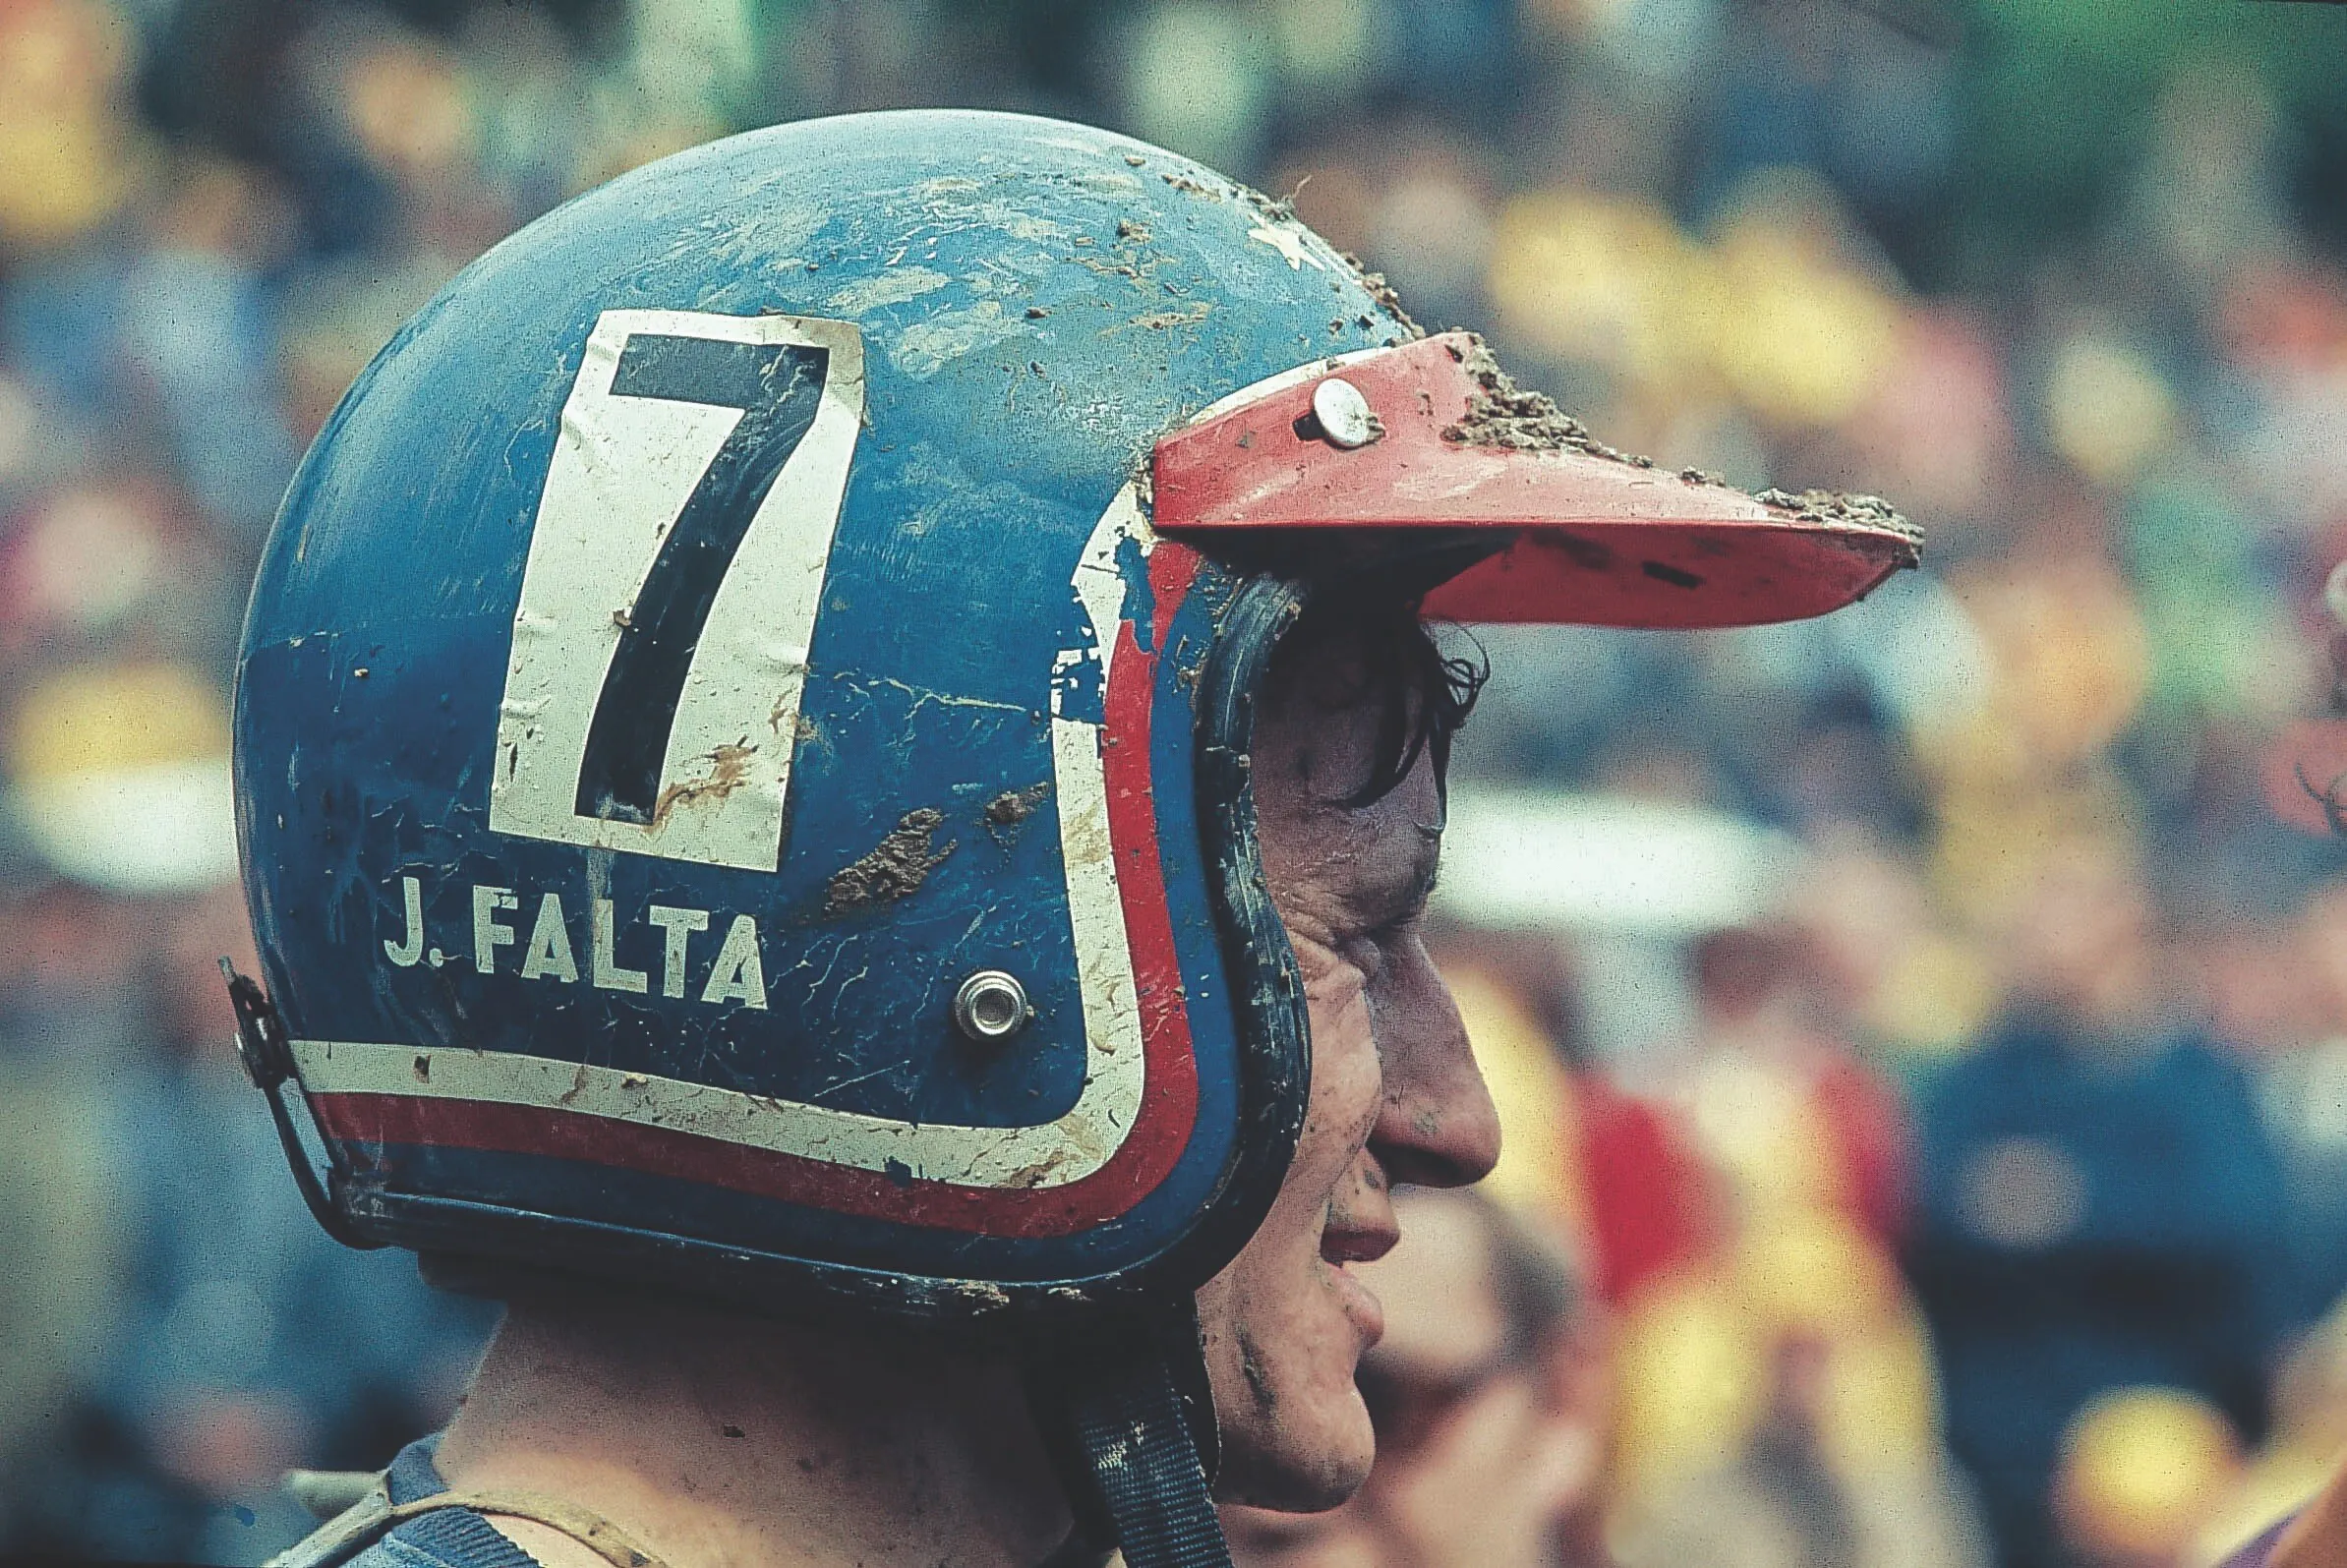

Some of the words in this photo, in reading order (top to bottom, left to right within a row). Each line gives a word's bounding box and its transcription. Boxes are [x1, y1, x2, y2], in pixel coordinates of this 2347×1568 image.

[574, 332, 830, 826] 7
[383, 876, 444, 967] J.
[472, 884, 769, 1011] FALTA
